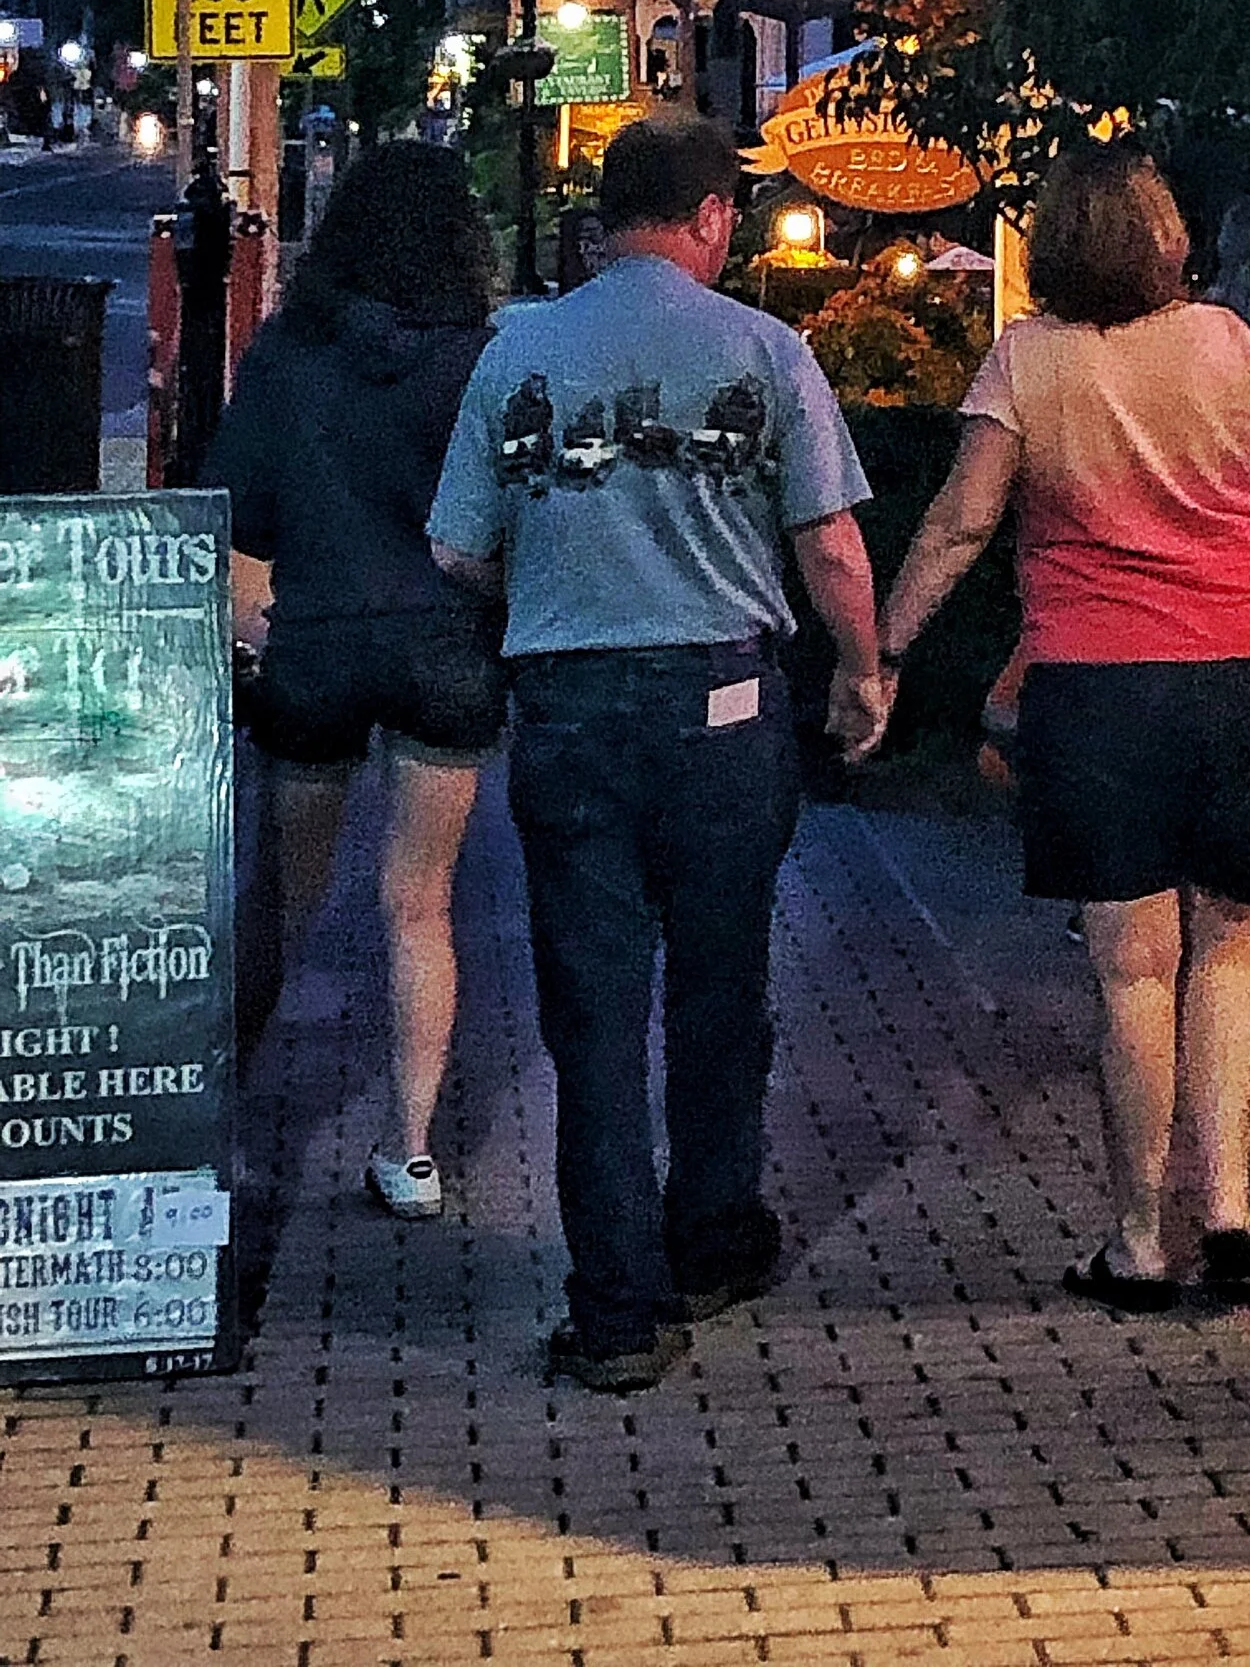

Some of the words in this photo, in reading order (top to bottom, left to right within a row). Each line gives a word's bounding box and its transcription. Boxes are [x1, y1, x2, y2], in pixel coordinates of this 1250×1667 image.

[56, 518, 217, 594] Tours
[11, 932, 95, 1010] Than
[101, 918, 213, 1001] Fiction
[99, 1064, 204, 1098] HERE
[1, 1113, 133, 1148] OUNTS
[132, 1250, 208, 1283] 8:00
[50, 1297, 118, 1332] TOUR
[134, 1298, 208, 1329] 6:00
